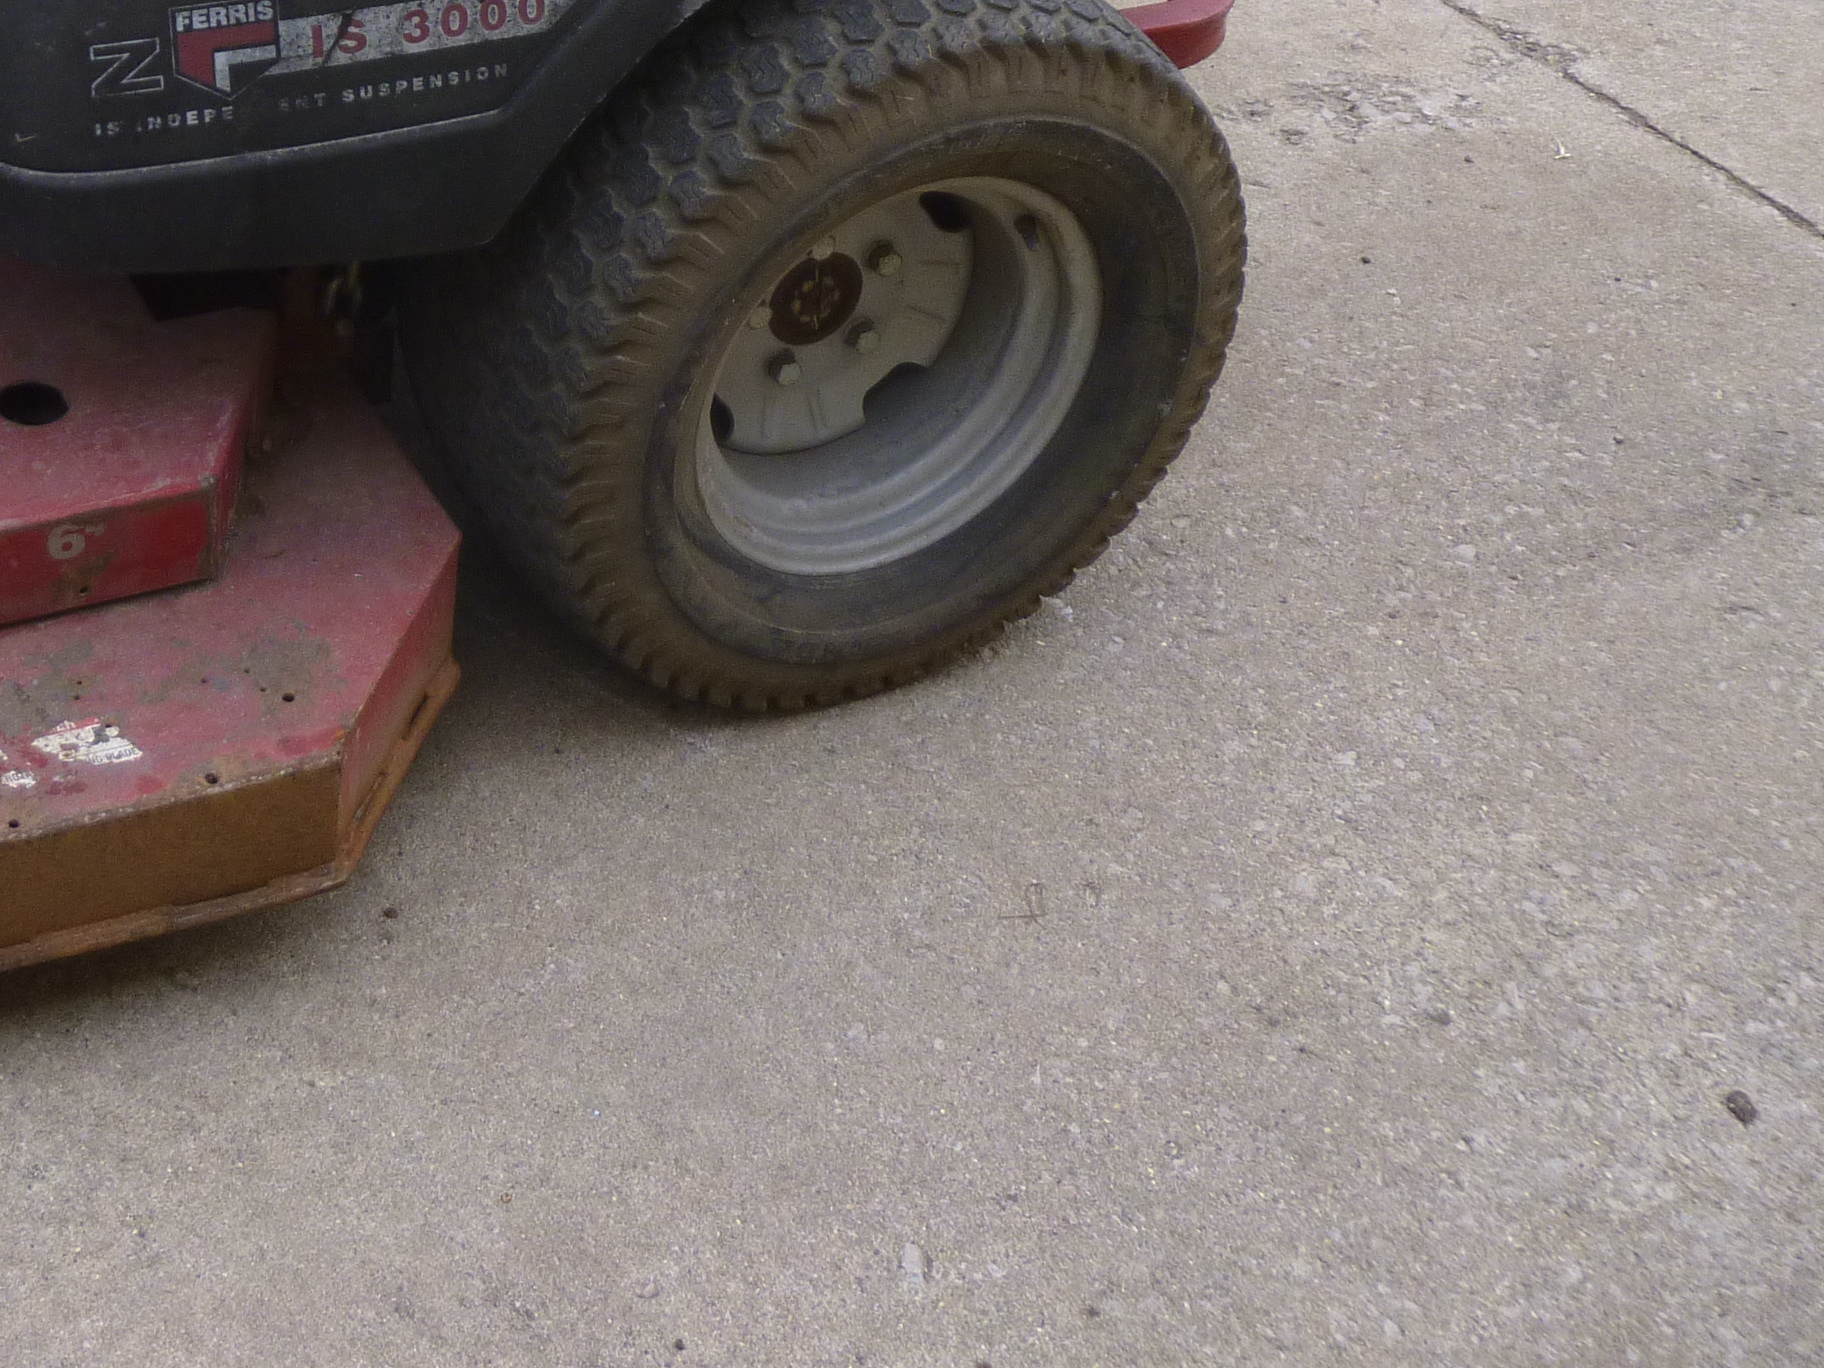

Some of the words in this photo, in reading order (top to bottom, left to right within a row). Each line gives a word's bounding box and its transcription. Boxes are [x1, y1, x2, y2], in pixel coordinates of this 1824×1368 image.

[175, 0, 274, 32] FERRIS
[311, 18, 367, 59] IS
[342, 62, 508, 103] SUSPENSION
